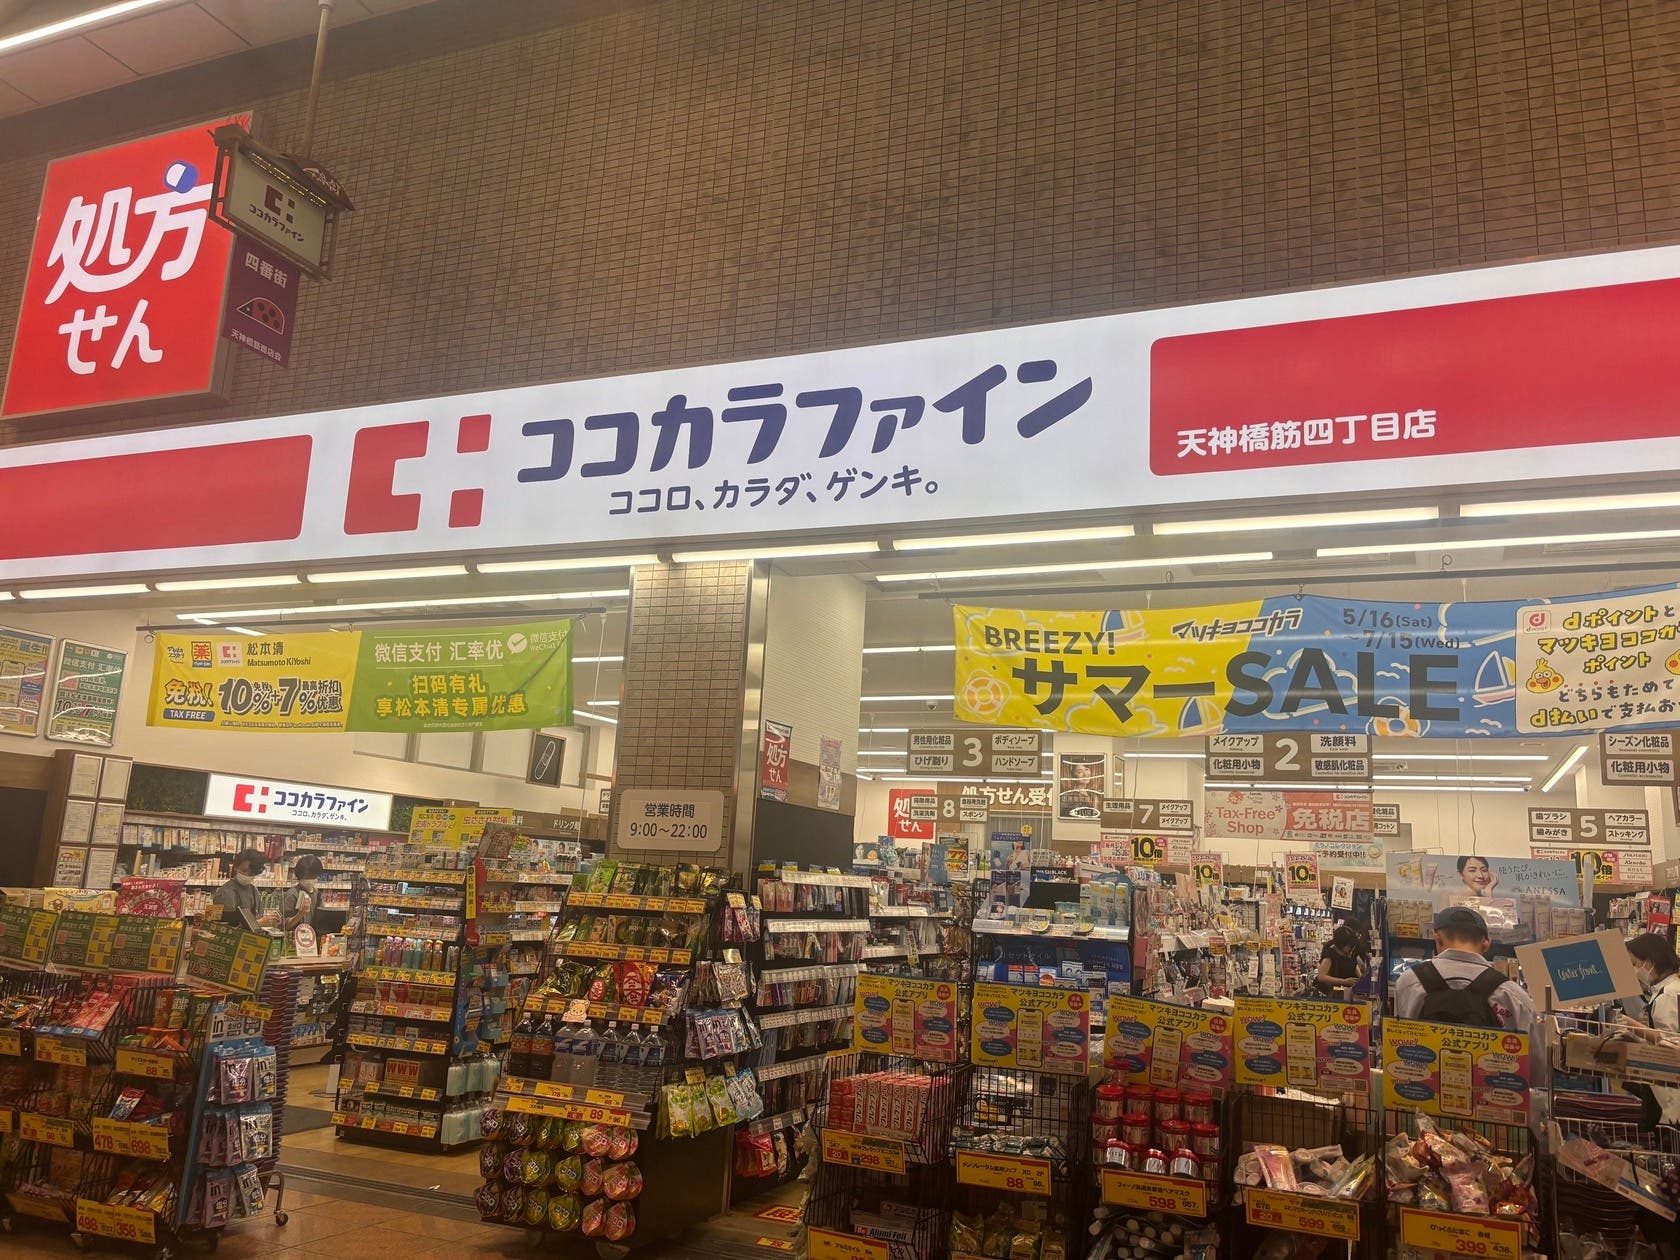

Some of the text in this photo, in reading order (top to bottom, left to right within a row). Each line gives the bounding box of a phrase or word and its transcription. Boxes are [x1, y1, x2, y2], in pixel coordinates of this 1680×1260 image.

[248, 203, 304, 242] ココカラファイン
[45, 161, 213, 304] 処方
[245, 252, 288, 288] 四番街
[58, 299, 163, 375] せん
[517, 359, 1093, 483] ココカラファイン
[1177, 409, 1437, 458] 天神橋筋四丁目店
[609, 465, 938, 515] ココロ、カラダ、ゲンキ。
[984, 625, 1116, 655] BREEZY!
[194, 644, 210, 659] 薬
[375, 640, 503, 663] 微信支付 汇率优
[247, 659, 285, 667] Matsumoto
[1583, 651, 1651, 673] ポイント
[413, 674, 486, 694] 扫码有礼
[1559, 681, 1674, 702] どちらもためて
[377, 694, 526, 717] 享松本清专属优惠
[170, 711, 206, 720] TAX FREE
[913, 735, 951, 745] 男性用化粧品
[995, 735, 1035, 745] ボディソープ
[1213, 736, 1259, 747] メイクアップ
[1320, 736, 1356, 747] 洗顔料
[1609, 736, 1669, 748] シーズン化粧品
[767, 743, 788, 768] 処方
[962, 737, 983, 767] 3
[1275, 738, 1300, 771] 2
[915, 756, 948, 766] ひげ剃り
[995, 756, 1035, 766] ハンドソープ
[1213, 759, 1260, 770] 化粧用小物
[1314, 760, 1364, 771] 敏感肌化粧品
[1611, 761, 1669, 774] 化粧用小物
[769, 767, 782, 783] せん
[274, 790, 368, 814] ココカラファイン
[943, 799, 955, 818] 8
[1161, 803, 1188, 811] メイクアップ
[645, 803, 695, 819] 営業時間
[1139, 805, 1153, 824] 7
[1216, 807, 1276, 820] Tax-Free
[1536, 812, 1567, 821] 歯ブラシ
[1608, 814, 1642, 822] ヘアカラー
[899, 820, 922, 832] せん
[1293, 808, 1370, 831] 免税店
[1227, 821, 1264, 836] Shop
[1536, 828, 1568, 836] 歯みがき
[1580, 816, 1598, 838] 5
[1608, 830, 1644, 838] ストッキング
[1526, 886, 1566, 896] ANESSA
[888, 978, 935, 990] マツキヨココカラ
[894, 989, 928, 999] 公式アプリ
[1011, 988, 1066, 1000] マツキヨココカラ
[1020, 998, 1058, 1009] 公式アプリ
[1276, 1002, 1339, 1014] マツキヨココカラ
[1149, 1004, 1207, 1022] マツキヨココカラ
[1287, 1012, 1331, 1023] 公式アプリ
[213, 1016, 224, 1033] in
[1158, 1016, 1199, 1030] 公式アプリ
[1430, 1026, 1498, 1040] マツキヨココカラ
[1442, 1038, 1490, 1050] 公式アプリ
[590, 1109, 603, 1119] 89
[95, 1134, 114, 1149] 478
[131, 1140, 151, 1154] 698
[861, 1154, 880, 1165] 298
[1006, 1177, 1024, 1188] 88
[210, 1183, 221, 1197] in
[1149, 1196, 1176, 1209] 598
[79, 1216, 98, 1231] 498
[116, 1222, 137, 1237] 358
[1299, 1216, 1325, 1229] 599
[870, 1228, 907, 1240] Alumi Foil
[1456, 1239, 1487, 1254] 399
